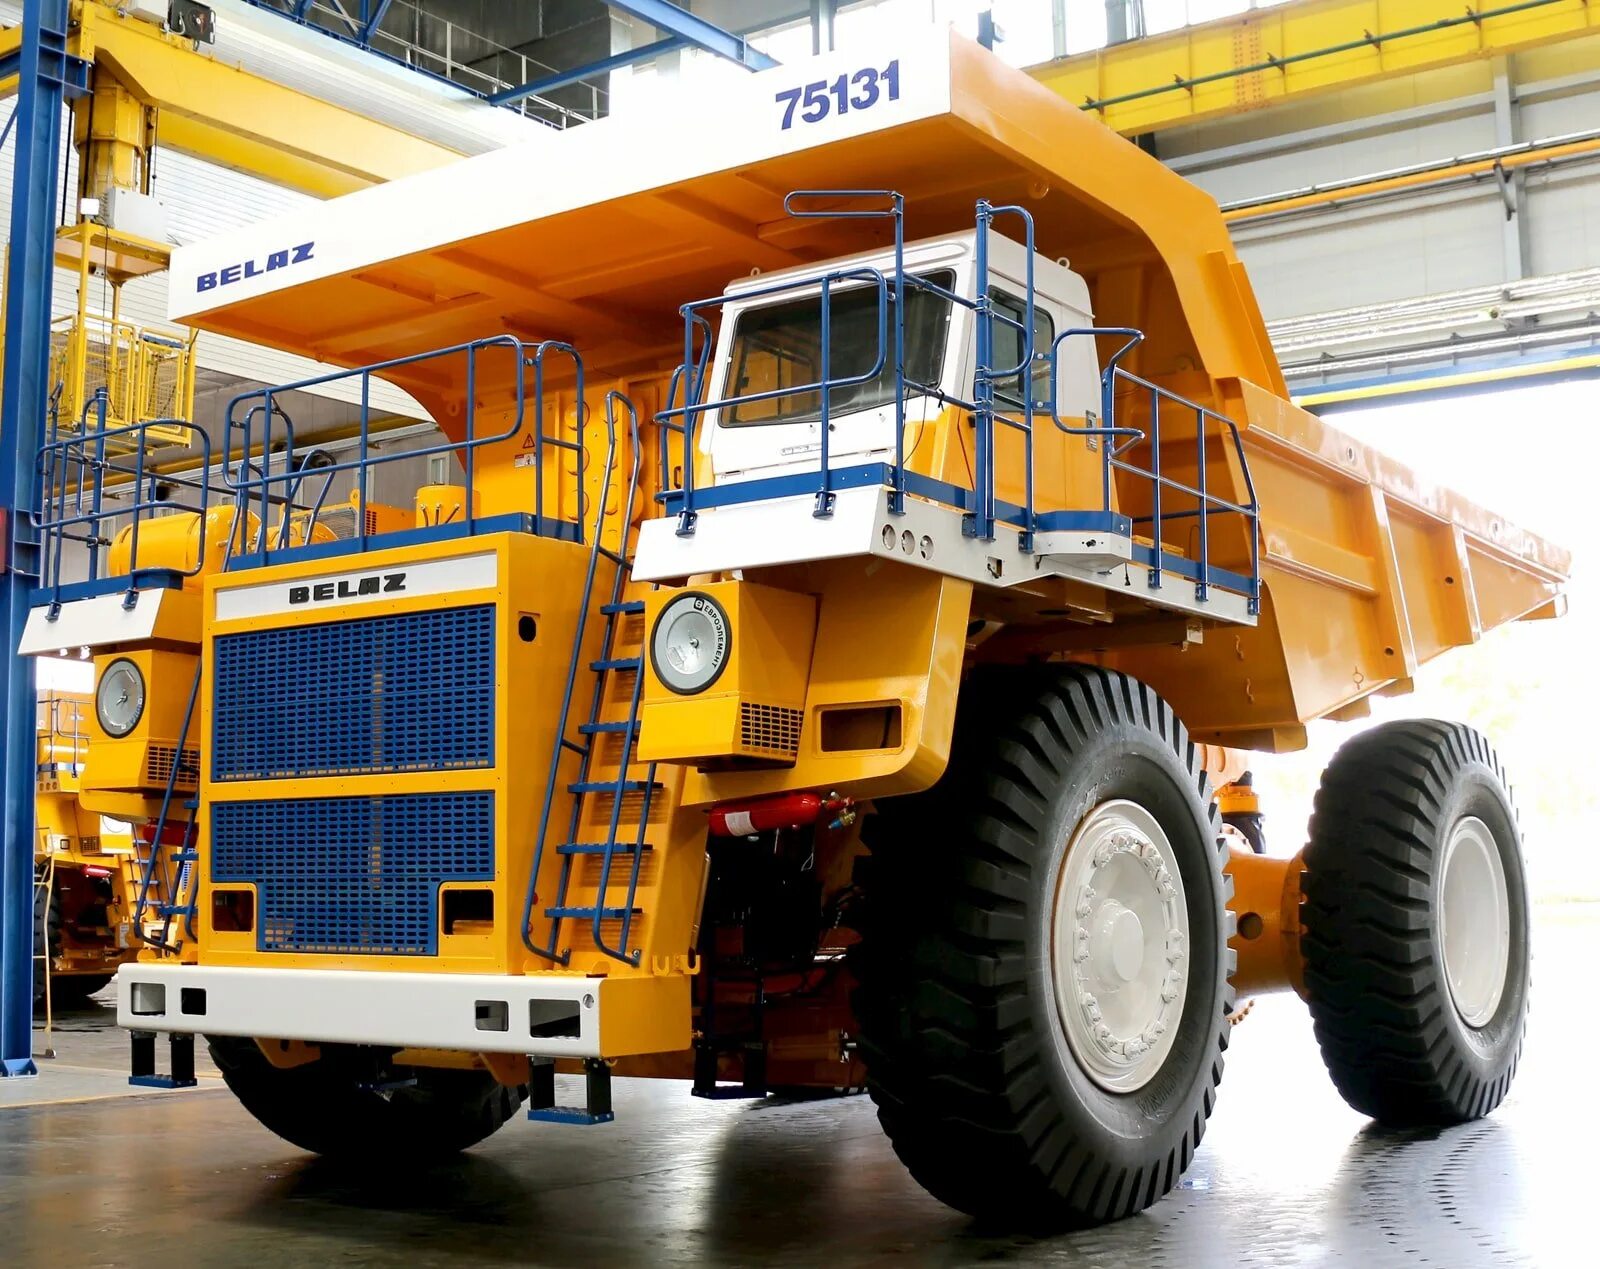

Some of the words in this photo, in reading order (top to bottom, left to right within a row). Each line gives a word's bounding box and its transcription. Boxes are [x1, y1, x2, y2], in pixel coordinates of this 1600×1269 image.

[775, 59, 899, 130] 75131
[197, 241, 314, 293] BELAZ
[289, 573, 406, 604] BELAZ
[703, 605, 724, 668] ЕВРОЭЛЕМЕНТ
